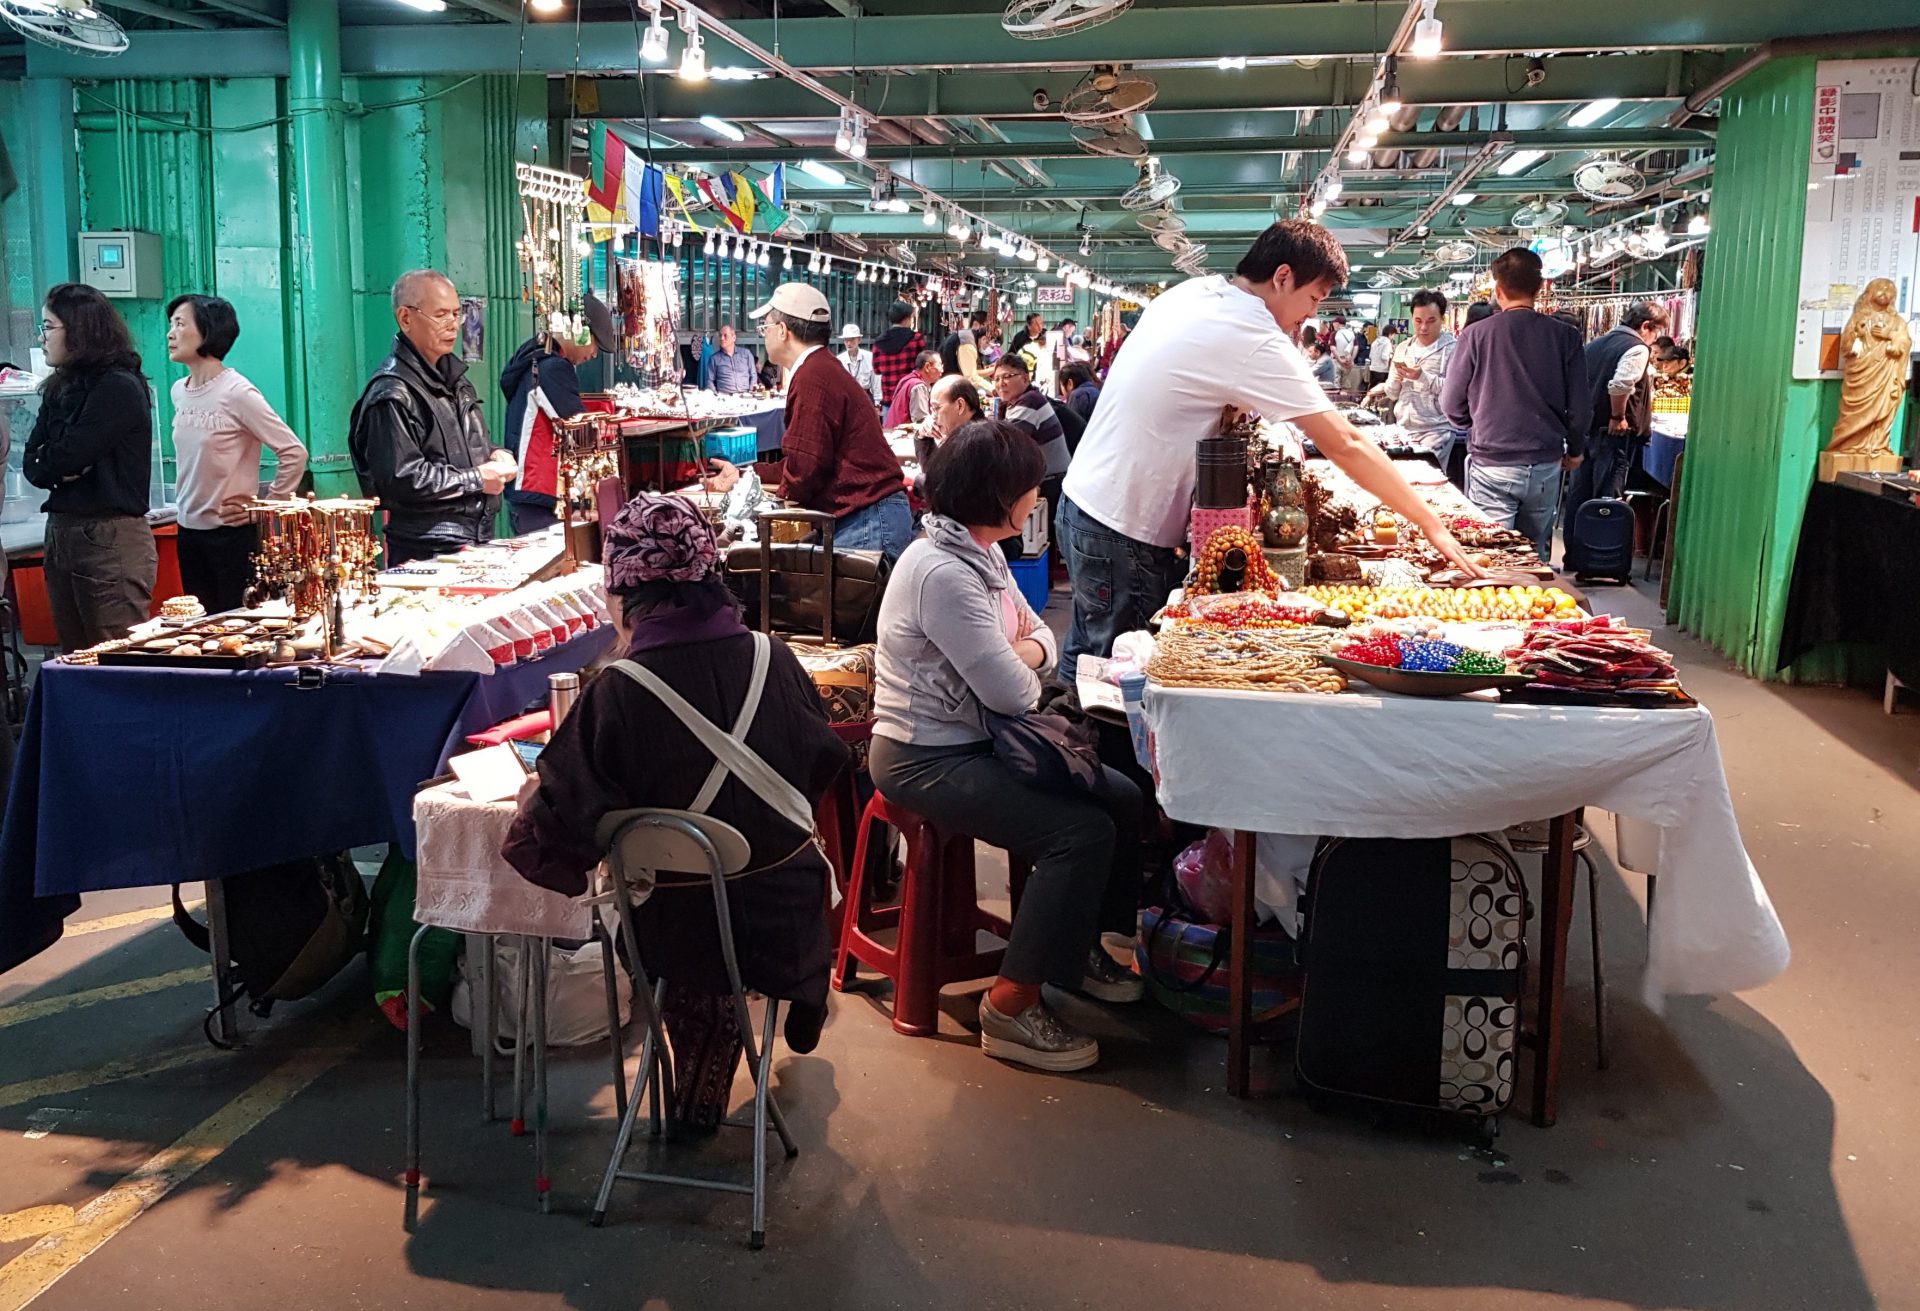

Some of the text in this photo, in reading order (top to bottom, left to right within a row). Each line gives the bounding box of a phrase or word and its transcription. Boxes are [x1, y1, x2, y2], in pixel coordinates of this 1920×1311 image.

[1818, 88, 1837, 144] 錄影中請微笑
[1039, 289, 1071, 301] 亮彩石
